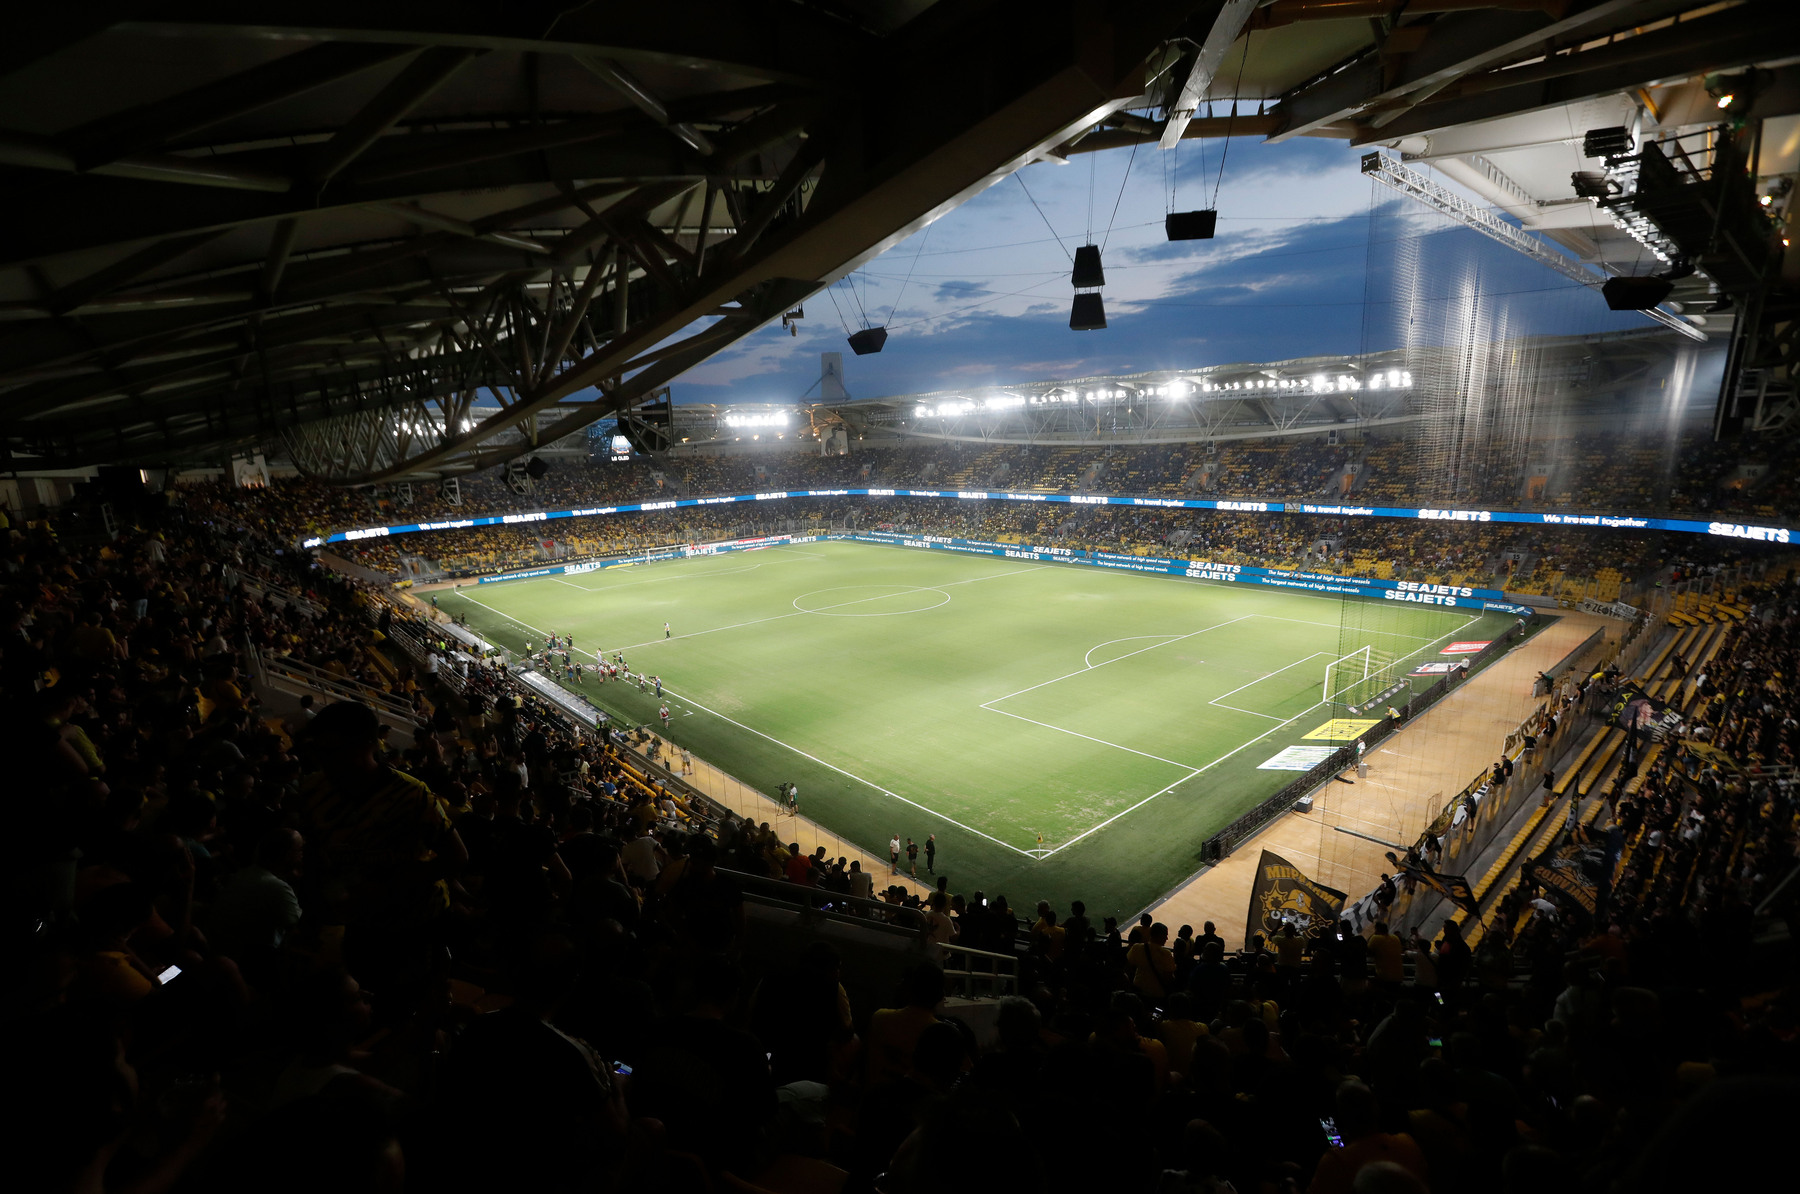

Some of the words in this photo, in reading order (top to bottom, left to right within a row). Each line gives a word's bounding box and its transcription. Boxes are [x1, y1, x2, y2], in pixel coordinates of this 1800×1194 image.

[641, 501, 676, 510] SEAJETS
[1070, 496, 1108, 504] SEAJETS
[1216, 501, 1267, 512] SEAJETS
[1304, 504, 1316, 513] We
[1318, 506, 1341, 514] travel
[1342, 506, 1374, 516] together
[502, 512, 547, 524] SEAJETS
[1418, 508, 1491, 522] SEAJETS
[1543, 514, 1561, 524] We
[1564, 516, 1600, 526] travel
[1601, 516, 1648, 528] together
[345, 526, 390, 541] SEAJETS
[1708, 522, 1790, 544] SEAJETS
[789, 536, 816, 544] SEAJETS
[904, 540, 930, 548] SEAJETS
[923, 536, 952, 544] SEAJETS
[1005, 550, 1039, 560] SEAJETS
[1033, 546, 1071, 556] SEAJETS
[564, 562, 600, 573] SEAJETS
[1189, 561, 1241, 573] SEAJETS
[1186, 569, 1235, 581] SEAJETS
[1397, 581, 1473, 597] SEAJETS
[1385, 590, 1456, 606] SEAJETS
